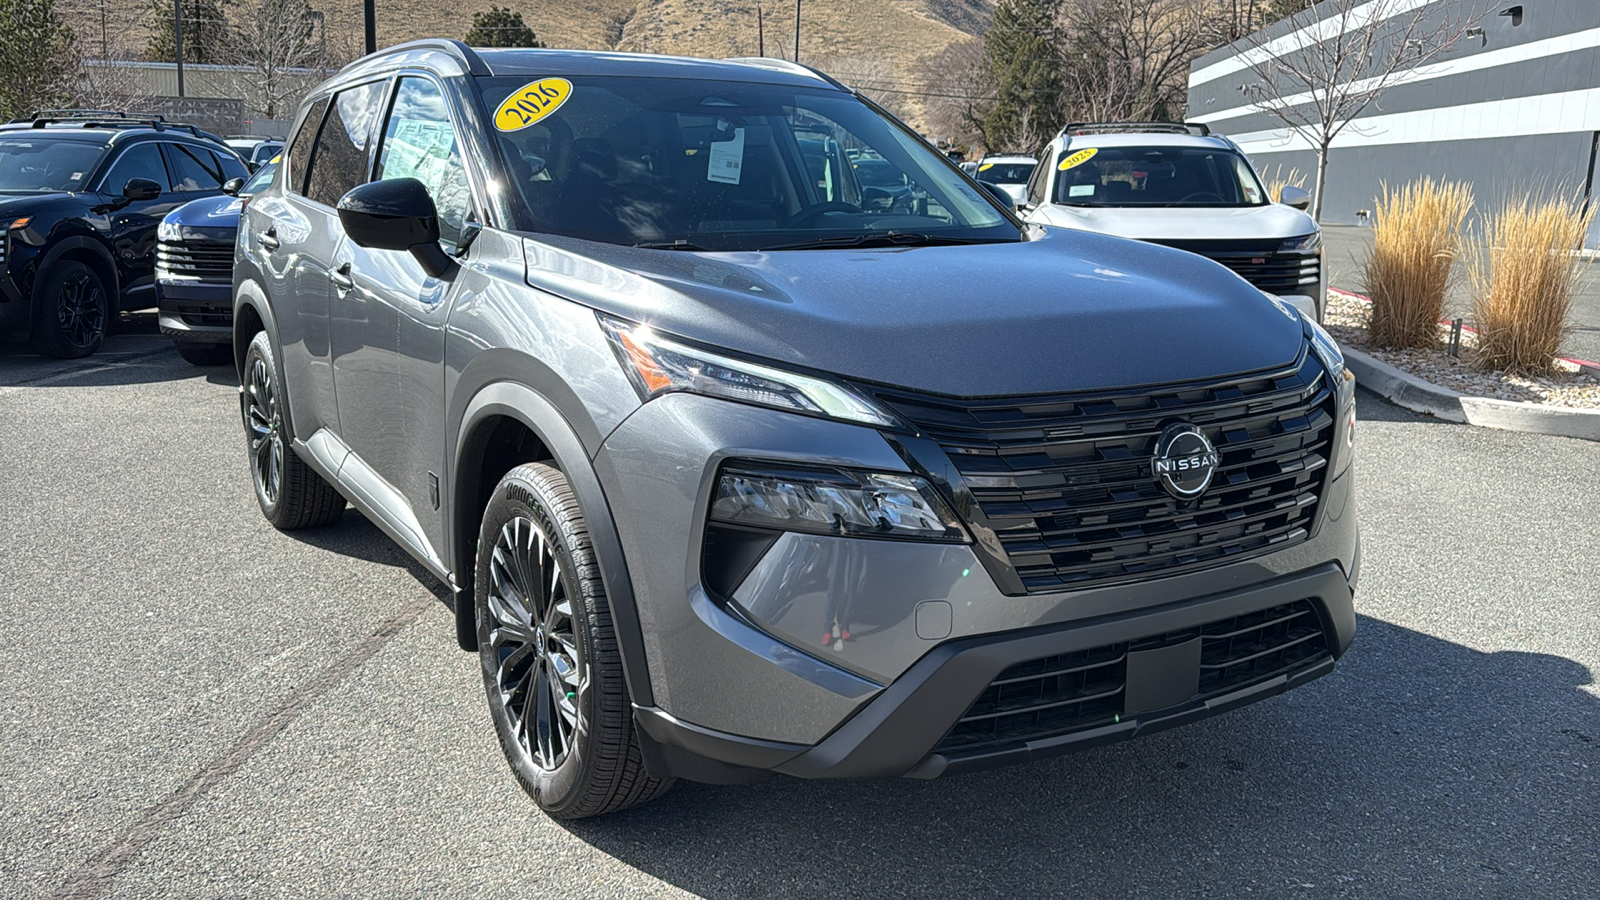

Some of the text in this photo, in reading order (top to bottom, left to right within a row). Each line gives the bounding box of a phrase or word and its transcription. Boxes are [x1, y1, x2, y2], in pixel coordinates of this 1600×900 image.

[505, 83, 559, 124] 2026
[1066, 150, 1091, 166] 2025
[1157, 453, 1218, 472] NISSAN
[506, 482, 564, 555] BRIDGESTONE
